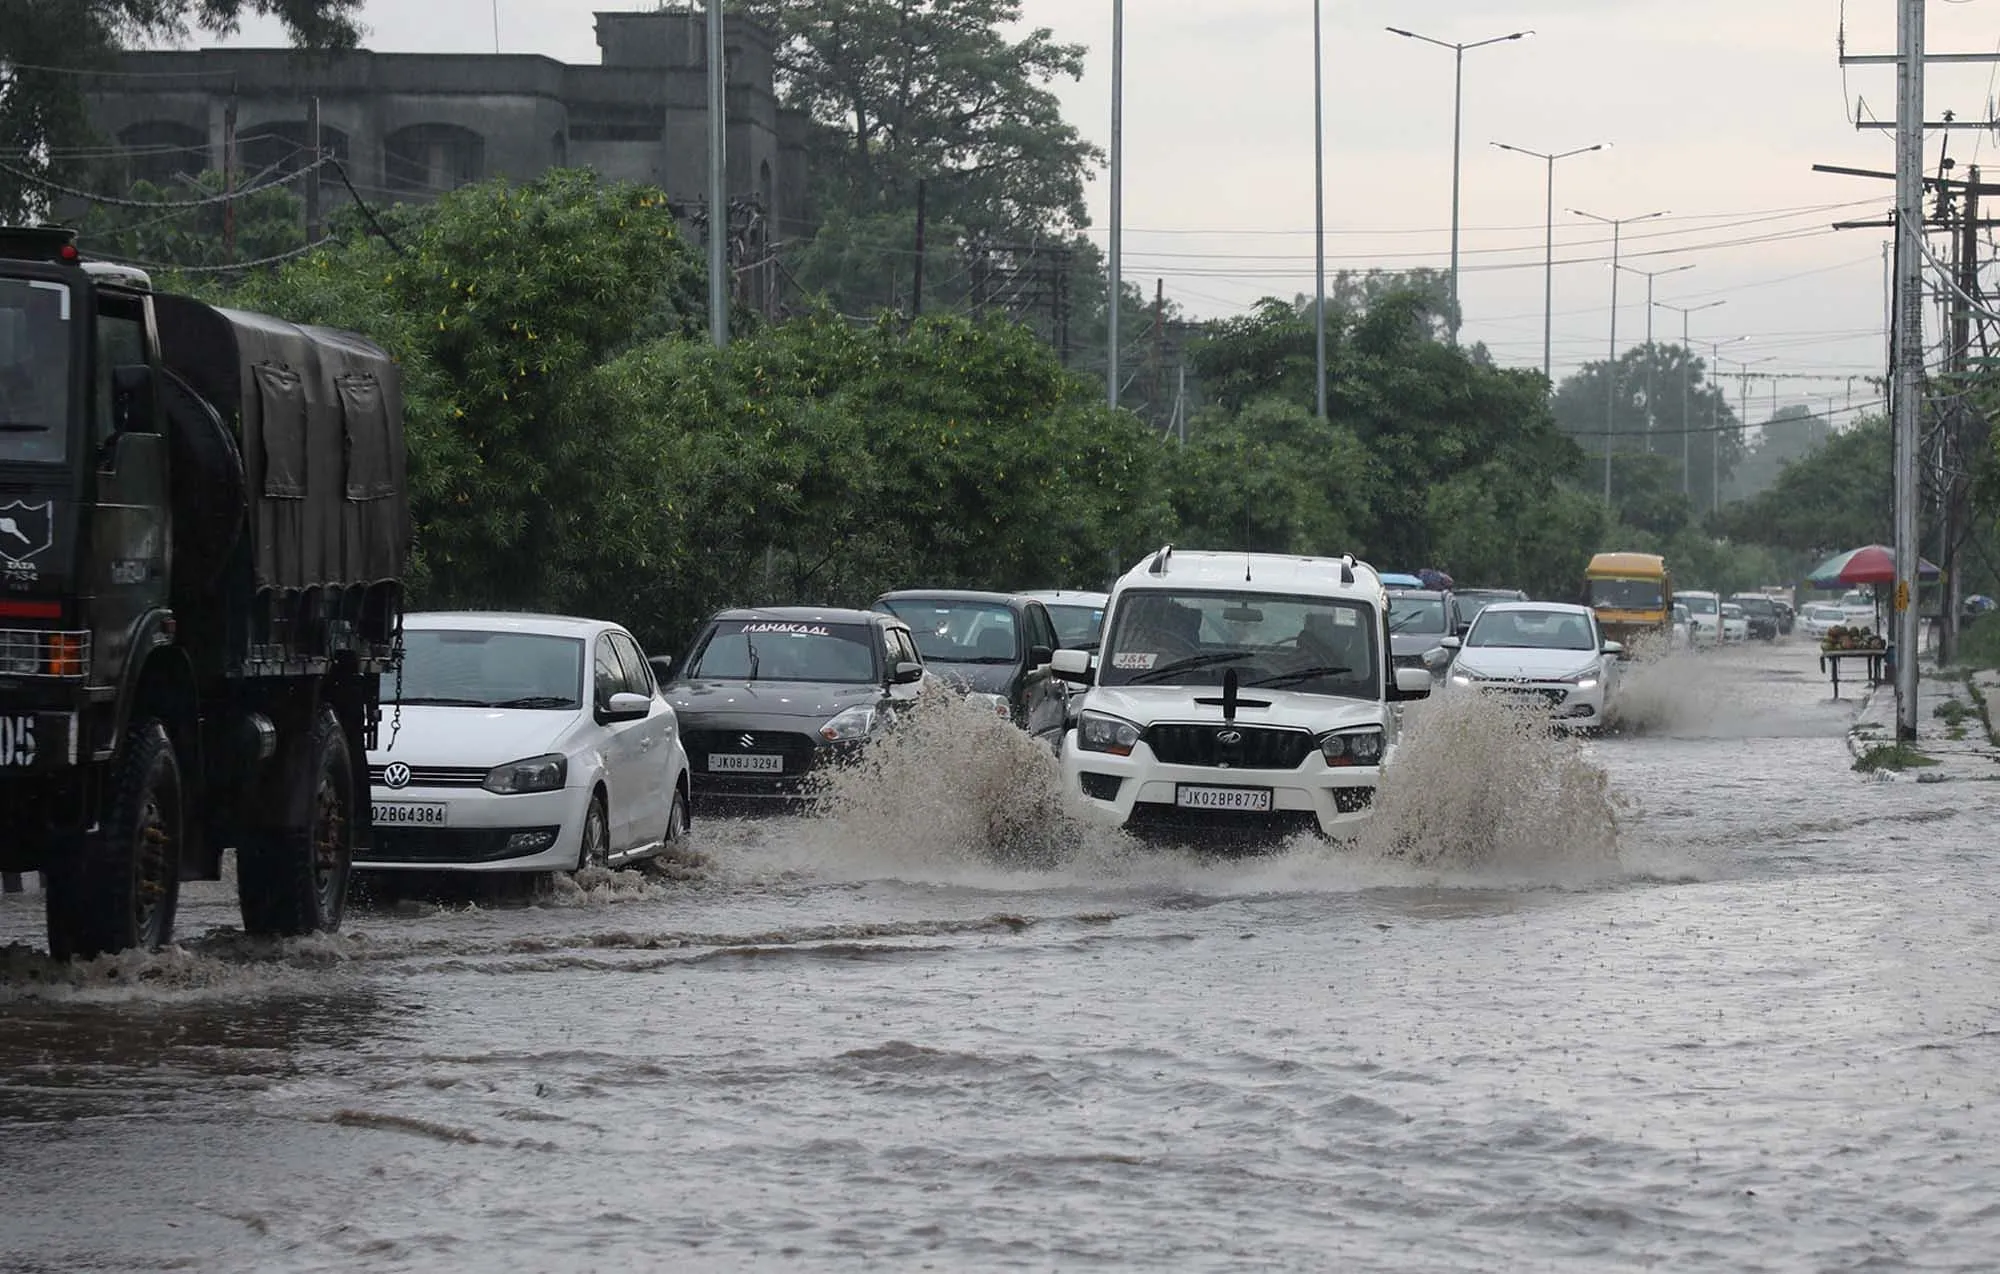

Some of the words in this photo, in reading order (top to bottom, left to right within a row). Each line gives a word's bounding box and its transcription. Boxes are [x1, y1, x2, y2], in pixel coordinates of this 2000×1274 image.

[741, 623, 829, 636] MAHAKAAL
[1119, 654, 1147, 664] J&K
[752, 757, 779, 769] 3294
[1185, 791, 1268, 807] JK02BP8779
